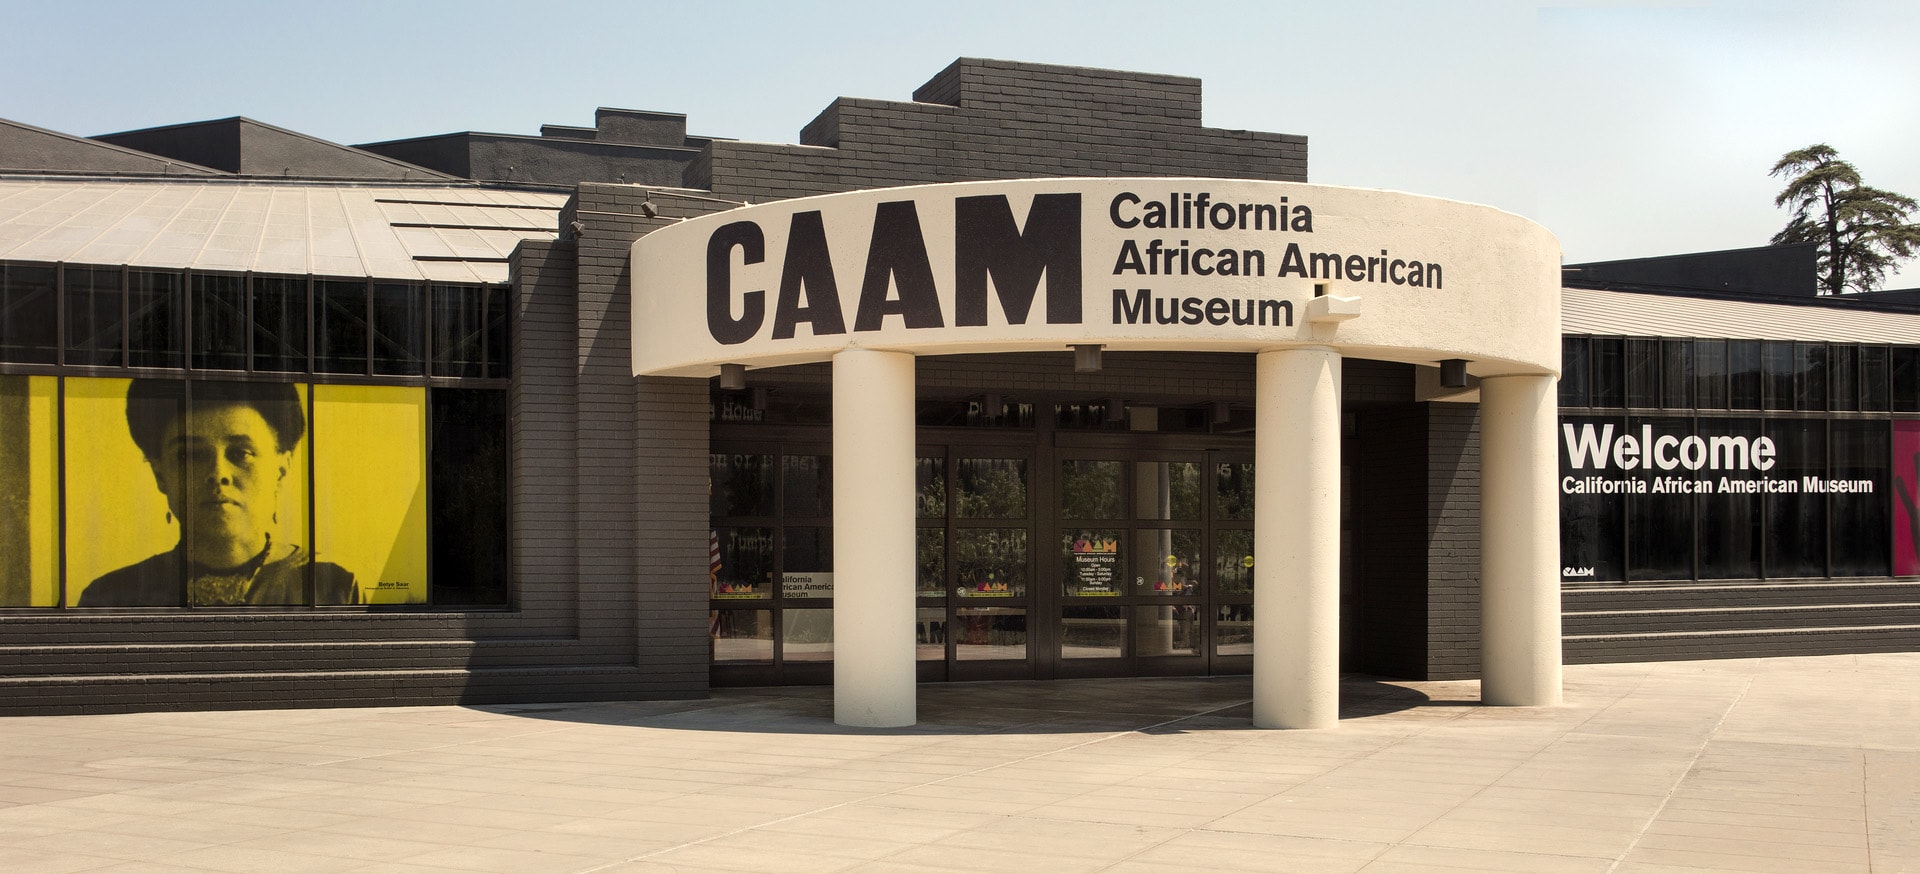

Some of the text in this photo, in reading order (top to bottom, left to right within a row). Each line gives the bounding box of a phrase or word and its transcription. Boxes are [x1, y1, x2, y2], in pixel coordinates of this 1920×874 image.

[1110, 192, 1313, 233] California
[707, 193, 1083, 345] CAAM
[1113, 239, 1442, 290] African American
[1112, 288, 1294, 327] Museum
[1563, 424, 1776, 471] Welcome
[1562, 476, 1873, 494] California African American Museum
[782, 575, 812, 583] lifornia
[783, 582, 834, 591] rican Americ
[1562, 566, 1595, 577] CAAM
